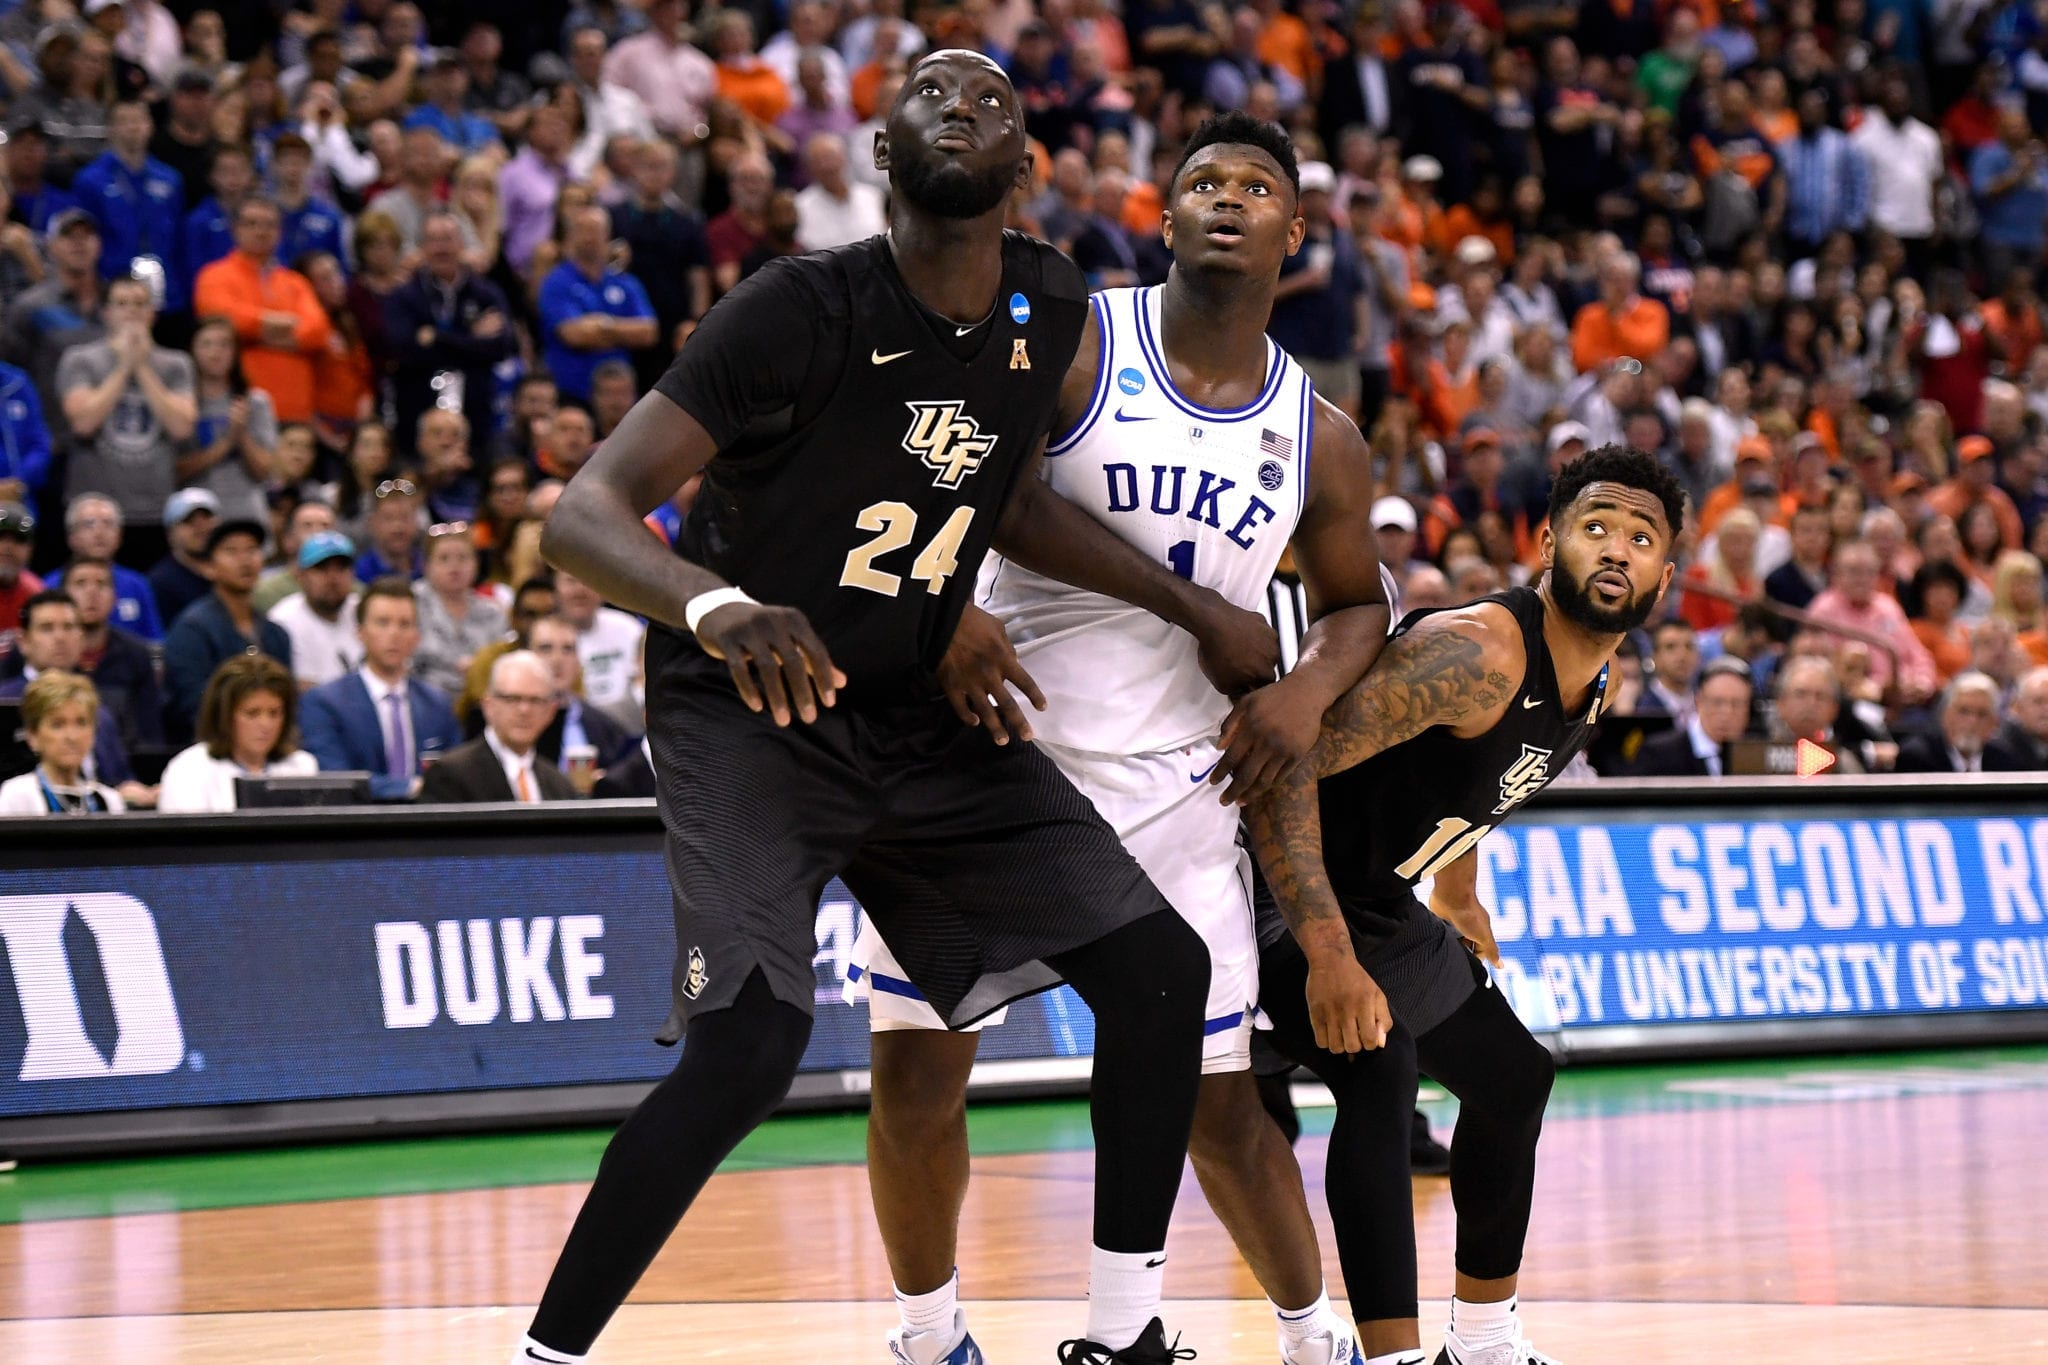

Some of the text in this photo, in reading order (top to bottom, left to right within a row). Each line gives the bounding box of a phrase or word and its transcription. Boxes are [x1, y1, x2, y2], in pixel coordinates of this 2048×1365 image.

[901, 400, 999, 490] UCF
[839, 500, 976, 597] 24
[1102, 462, 1276, 550] DUKE
[1168, 540, 1195, 581] 1
[1475, 823, 1637, 942] CAA
[1648, 818, 1967, 934] SECOND
[373, 914, 616, 1029] DUKE
[1541, 952, 1603, 1023] BY
[1613, 942, 1900, 1021] UNIVERSITY
[1909, 940, 1966, 1009] OF
